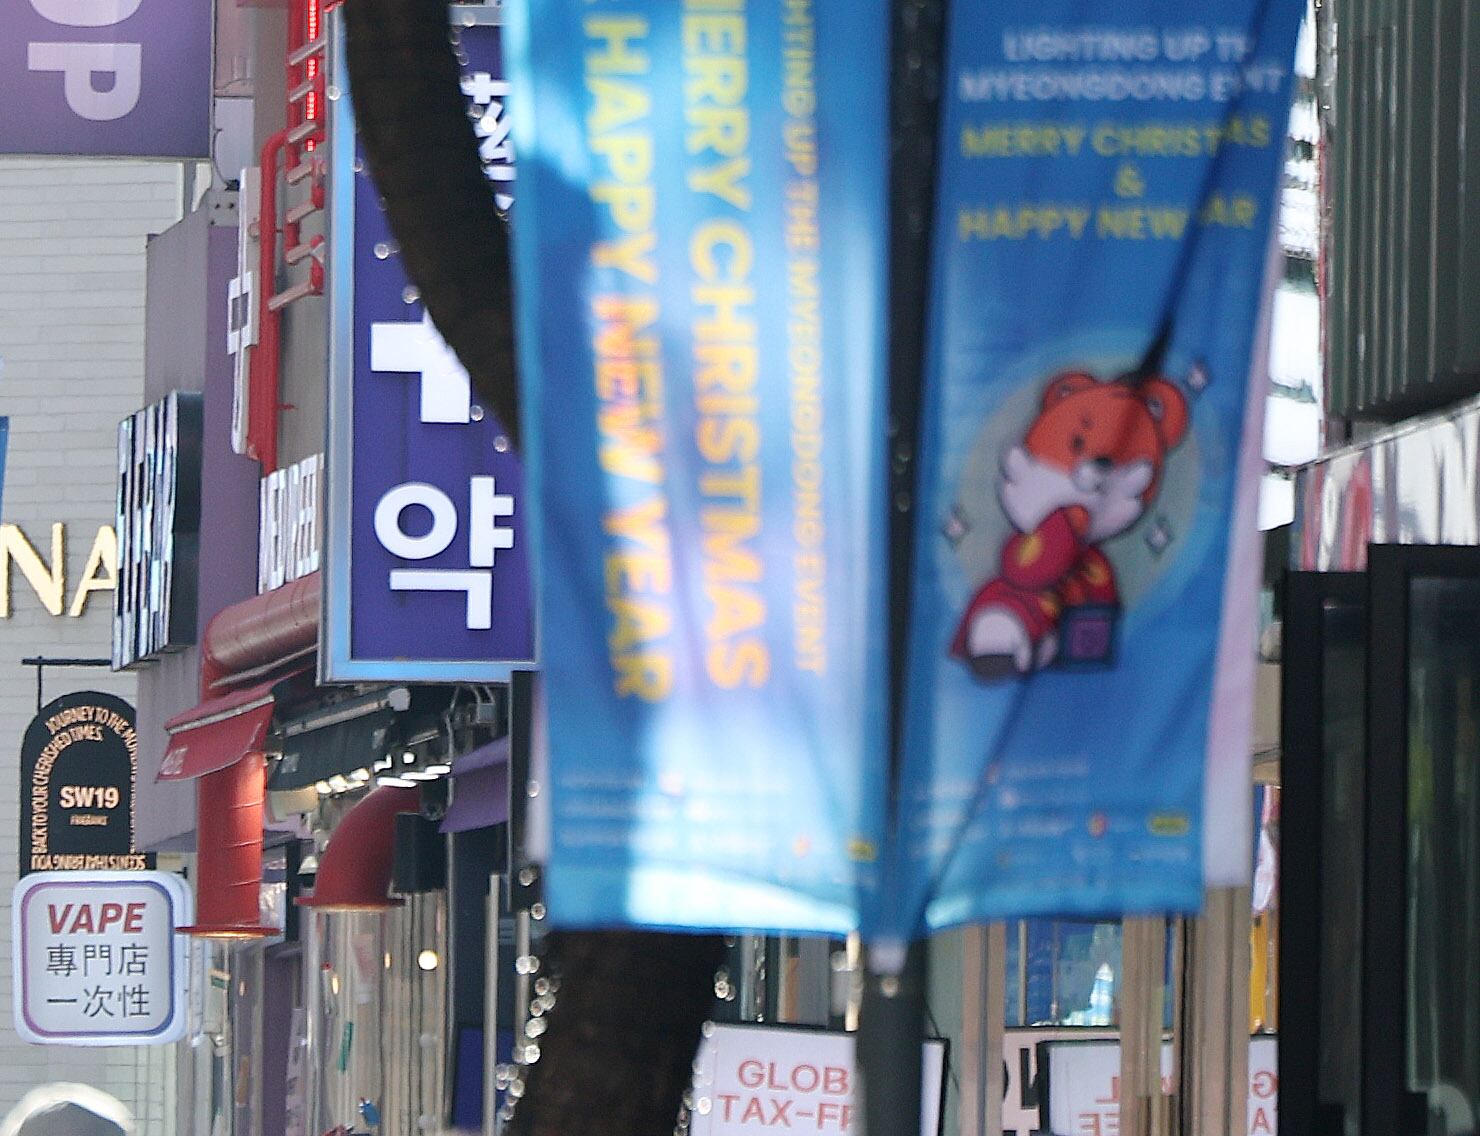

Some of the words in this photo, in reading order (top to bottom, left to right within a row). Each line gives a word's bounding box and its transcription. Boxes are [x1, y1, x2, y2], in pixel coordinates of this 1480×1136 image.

[1002, 28, 1159, 62] LIGHTING
[1162, 30, 1208, 62] UP
[681, 0, 757, 212] ERRY
[583, 15, 658, 286] HAPPY
[961, 122, 1087, 157] MERRY
[1115, 164, 1145, 199] &
[958, 204, 1088, 241] HAPPY
[1096, 205, 1189, 241] NEW
[690, 219, 772, 692] CHRISTMAS
[603, 493, 674, 704] YEAR
[58, 785, 120, 809] SW19
[47, 902, 146, 934] VAPE
[45, 943, 150, 978] 專門店
[45, 982, 151, 1018] 一次性
